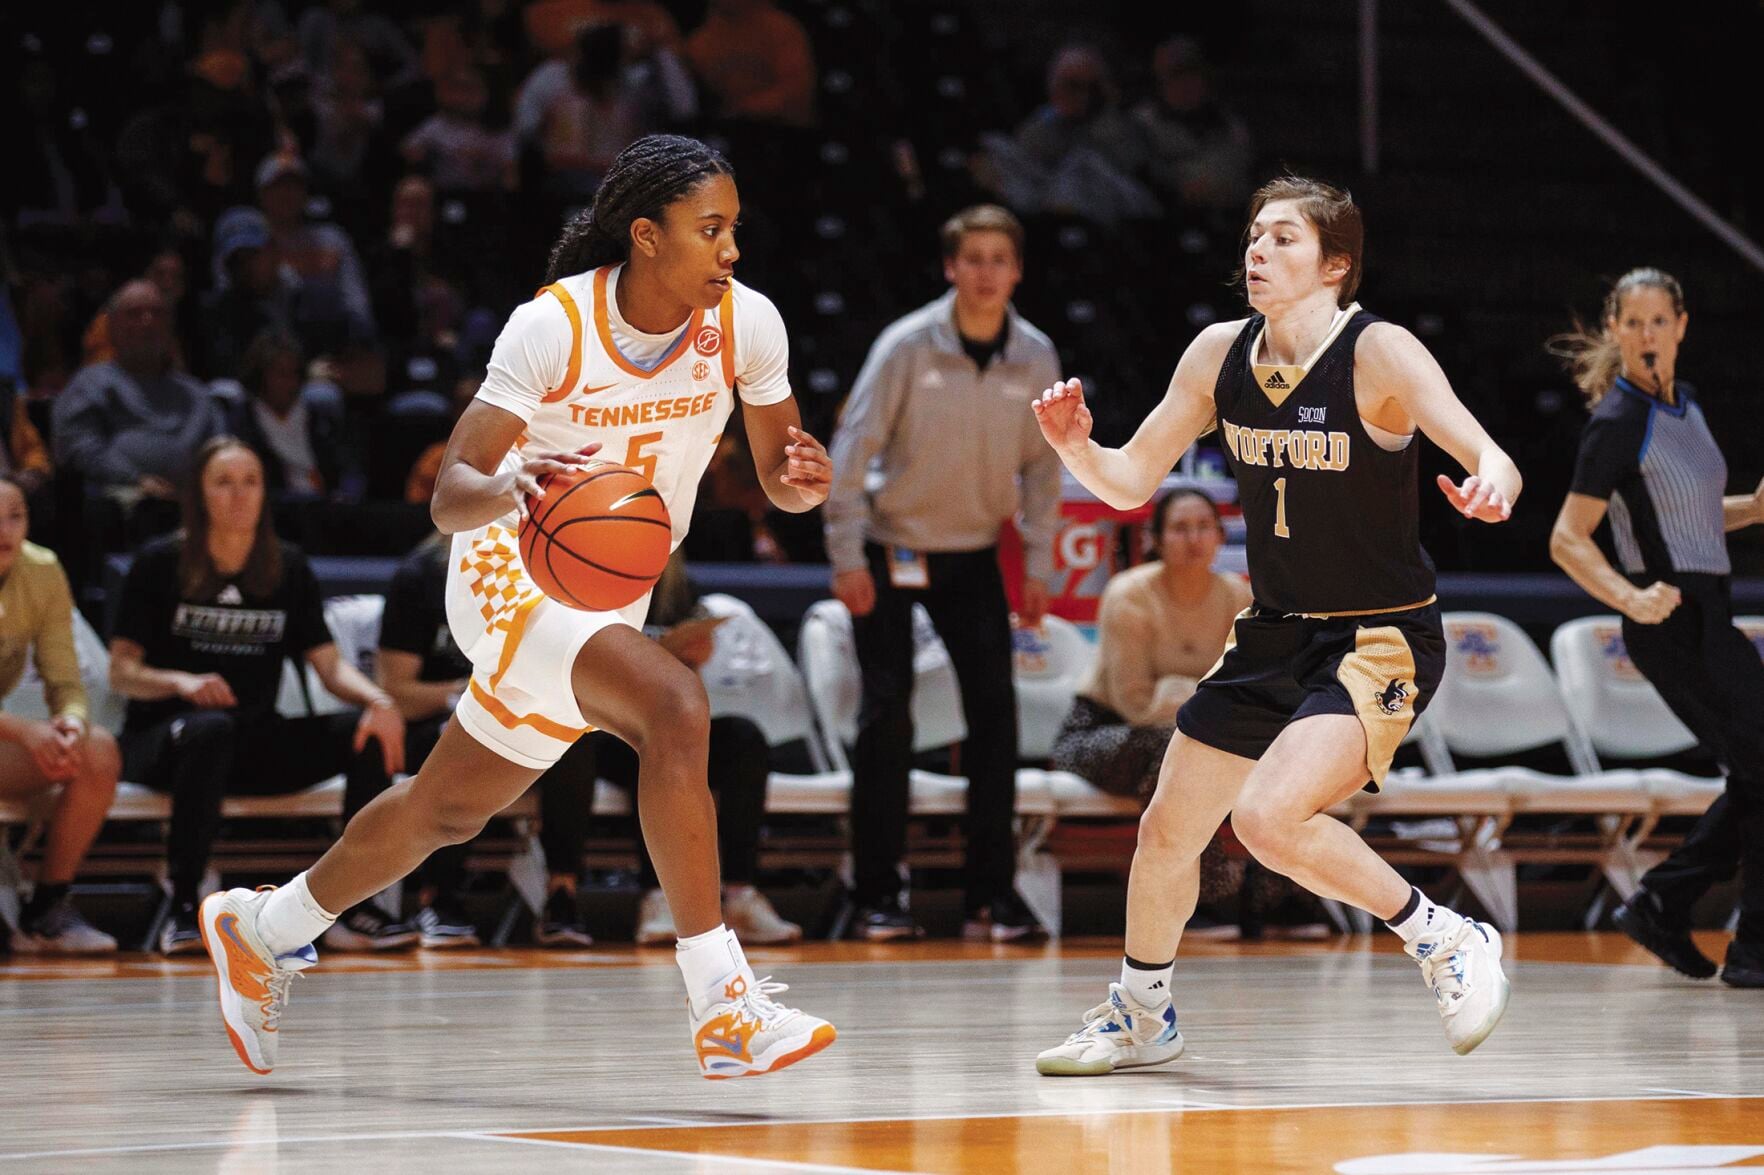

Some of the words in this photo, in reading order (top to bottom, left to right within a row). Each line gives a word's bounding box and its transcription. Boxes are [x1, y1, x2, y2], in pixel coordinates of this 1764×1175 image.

[568, 392, 718, 427] TENNESSEE
[1264, 381, 1290, 390] adidas
[624, 431, 664, 485] 5
[1222, 418, 1350, 472] WOFFORD
[1273, 477, 1290, 539] 1
[1062, 525, 1096, 567] G
